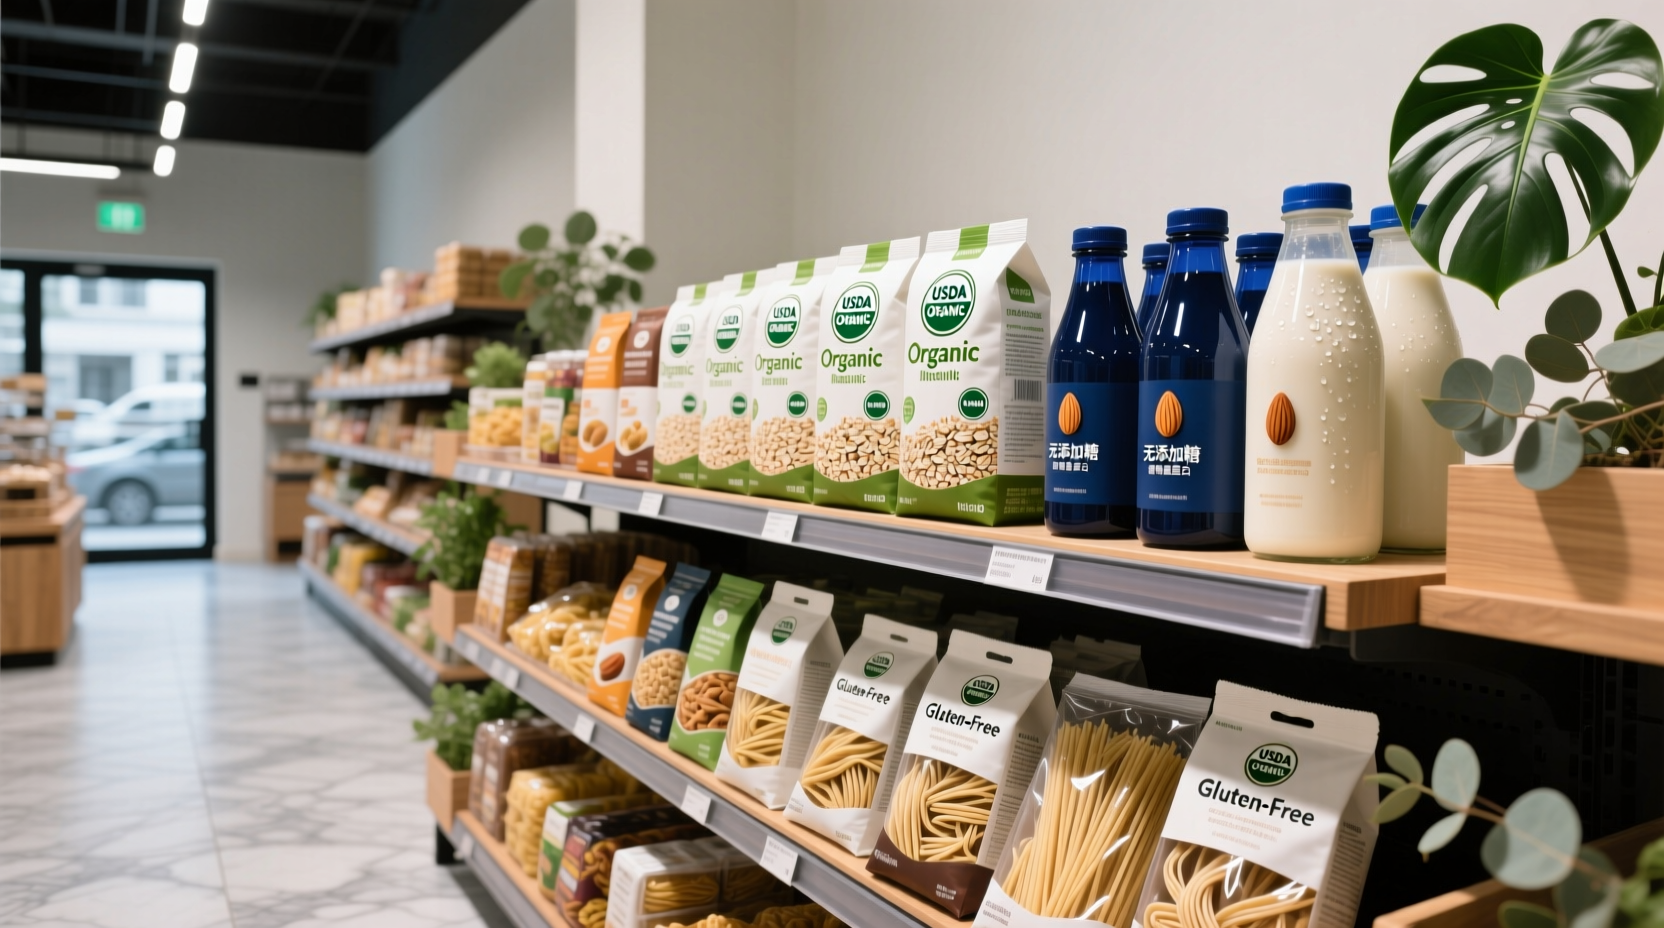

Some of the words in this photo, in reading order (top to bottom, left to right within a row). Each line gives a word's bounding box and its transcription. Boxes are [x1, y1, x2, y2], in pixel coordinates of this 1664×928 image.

[842, 295, 872, 309] USDA
[932, 284, 967, 301] USDA
[755, 352, 803, 375] Organic
[821, 347, 883, 373] Organic
[908, 340, 980, 369] Organic
[1143, 444, 1202, 465] 无添加糖
[1259, 748, 1291, 767] USDA
[1198, 778, 1315, 827] Gluten-Free
